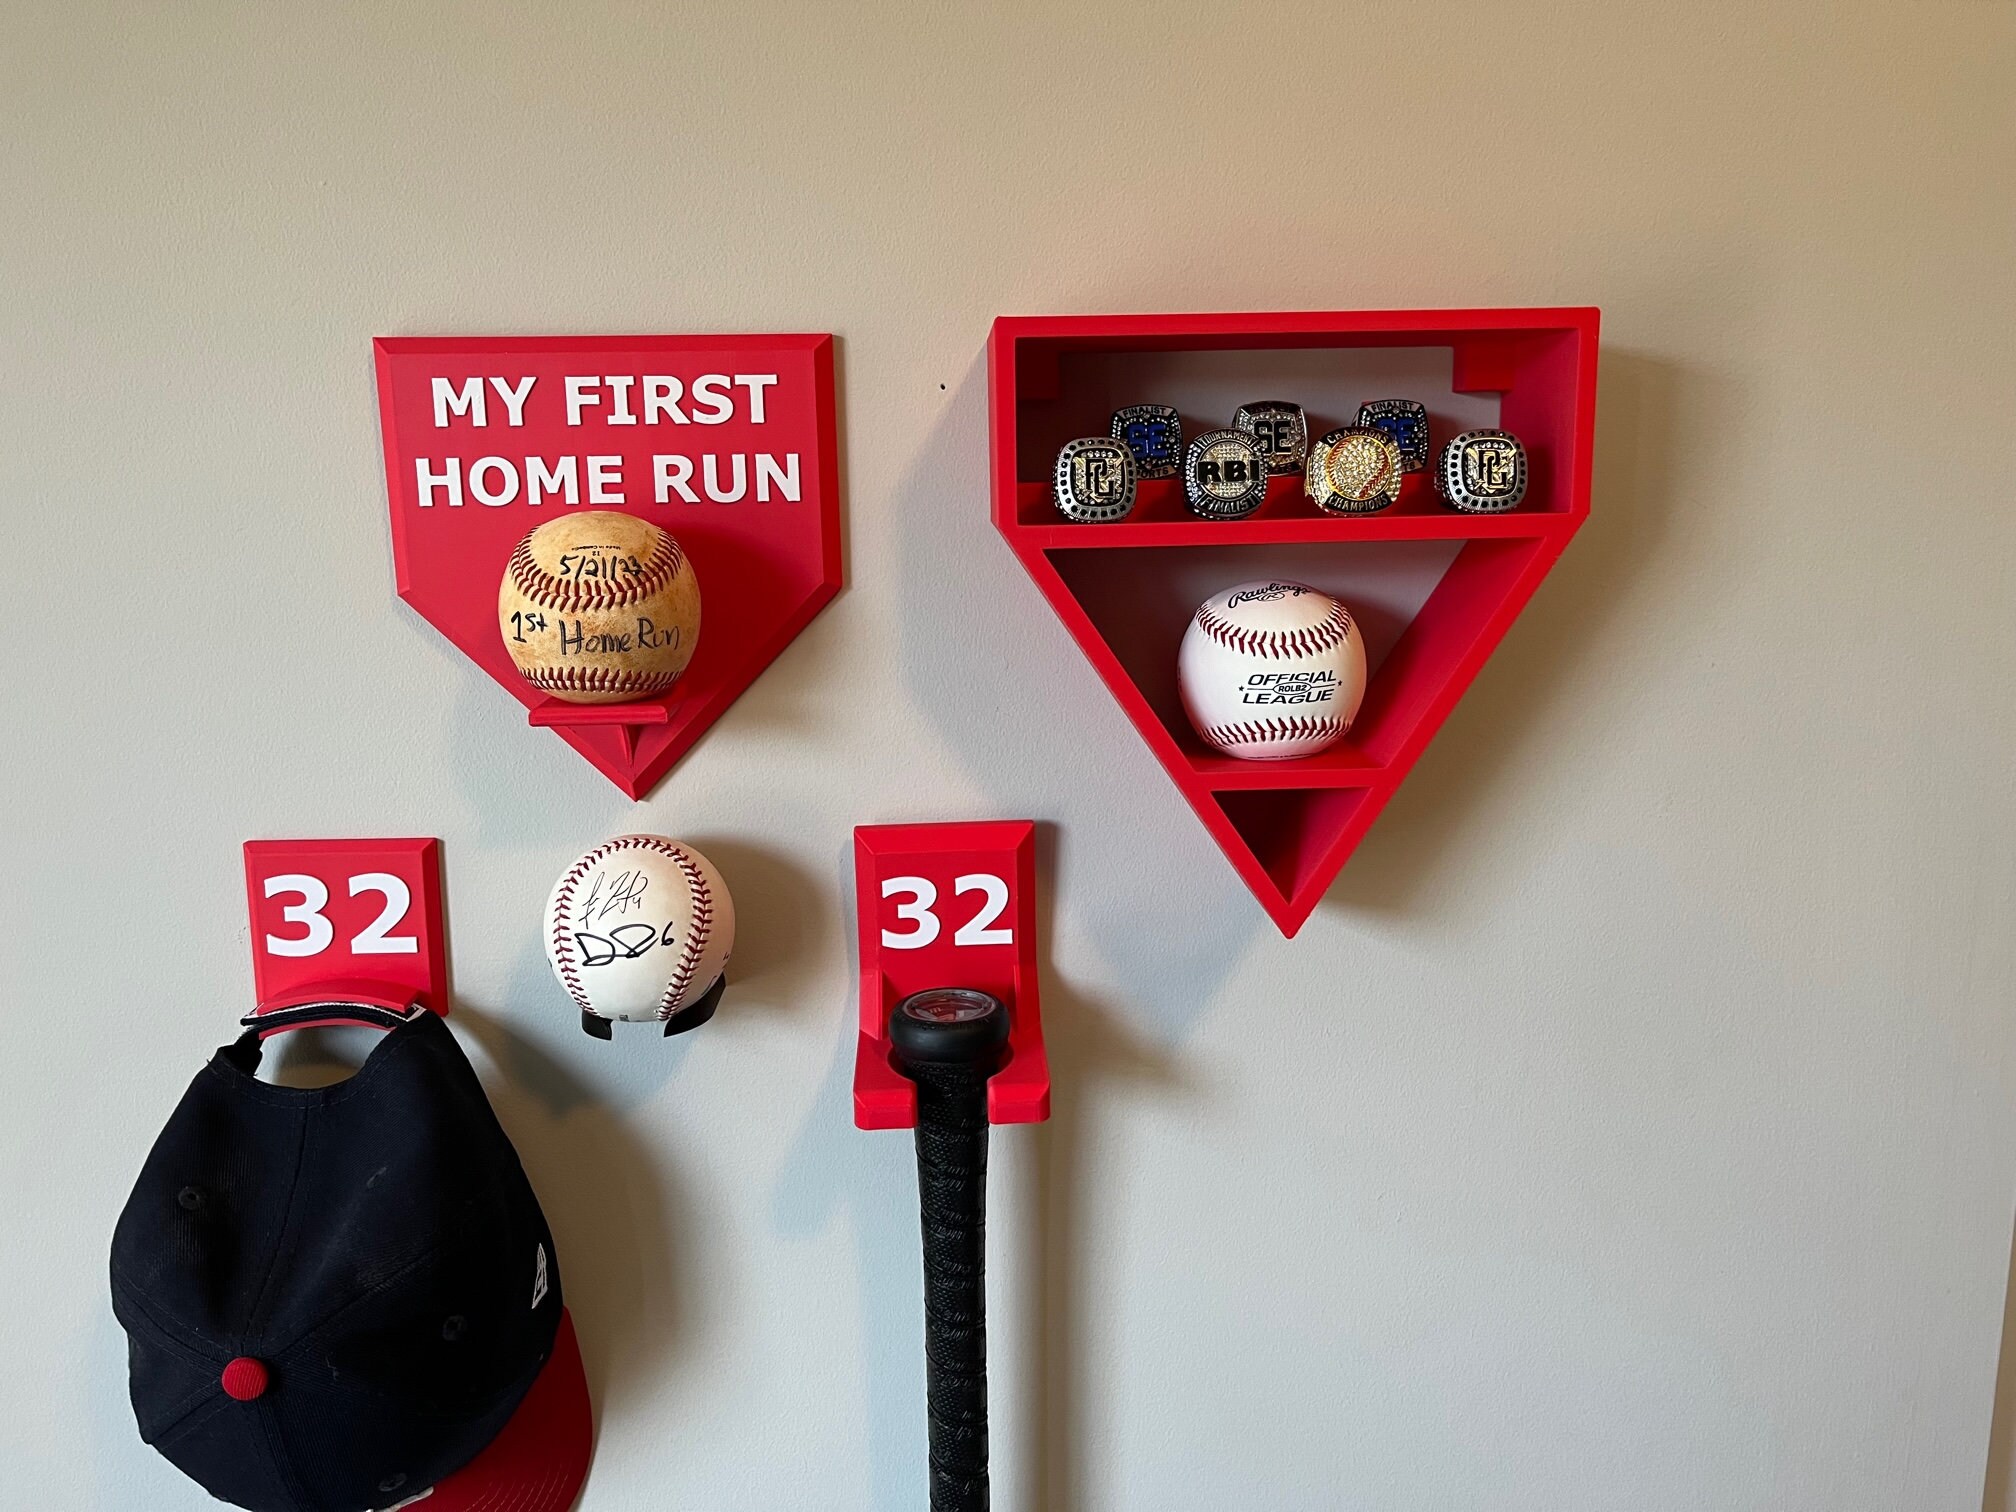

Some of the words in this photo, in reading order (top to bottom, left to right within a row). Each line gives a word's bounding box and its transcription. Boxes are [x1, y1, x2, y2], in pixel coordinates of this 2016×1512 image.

[431, 376, 537, 427] MY
[564, 374, 777, 426] FIRST
[1122, 405, 1167, 418] FINALIST
[1371, 401, 1415, 413] FINALIST
[1128, 424, 1168, 459] SE
[1198, 430, 1257, 449] TOURNAMENT
[1253, 420, 1293, 455] SE
[1326, 428, 1389, 445] CHAMPIONS
[415, 455, 625, 507] HOME
[653, 453, 801, 504] RUN
[1197, 459, 1260, 482] RBI
[1199, 493, 1258, 514] FINALIST
[1328, 494, 1389, 513] CHAMPIONS
[1228, 583, 1311, 608] Rawlings
[511, 611, 548, 643] 1st
[559, 620, 633, 655] Home
[637, 617, 680, 650] Run
[1247, 670, 1336, 686] OFFICIAL
[1278, 684, 1307, 693] ROLB2
[1242, 688, 1335, 704] LEAGUE
[262, 872, 419, 957] 32
[881, 873, 1014, 950] 32
